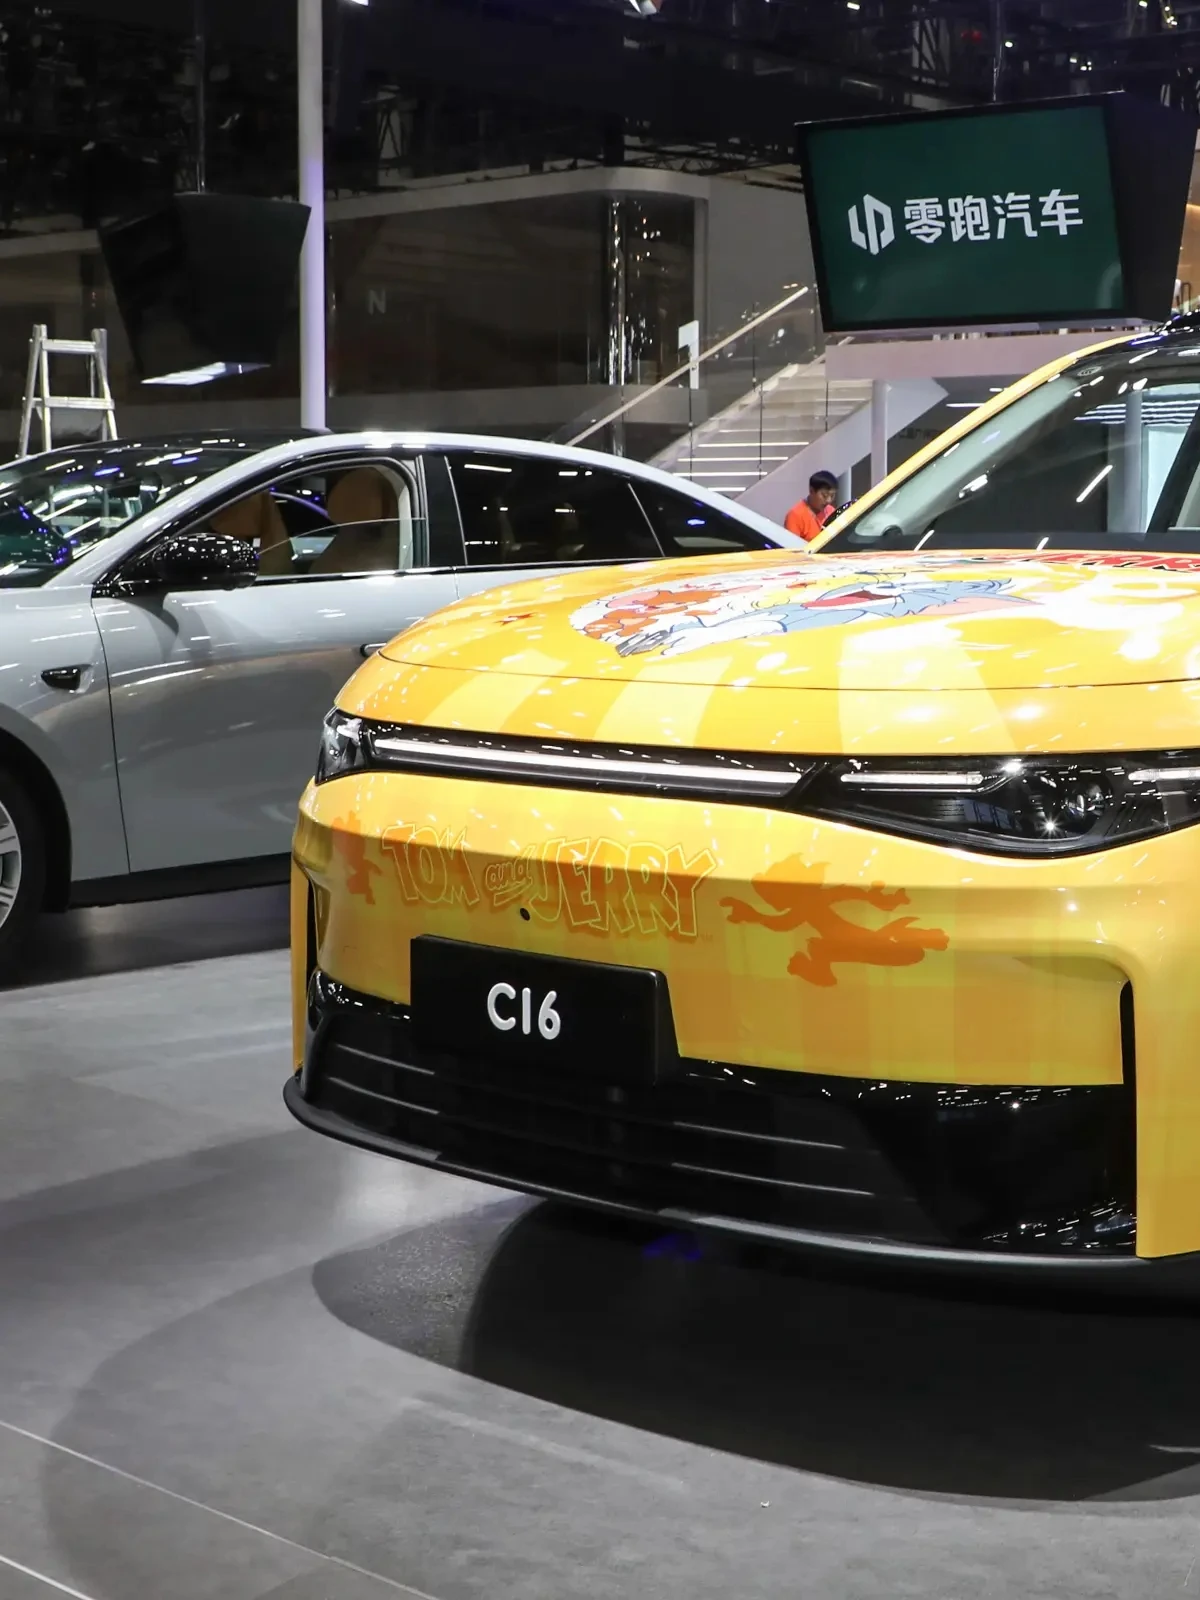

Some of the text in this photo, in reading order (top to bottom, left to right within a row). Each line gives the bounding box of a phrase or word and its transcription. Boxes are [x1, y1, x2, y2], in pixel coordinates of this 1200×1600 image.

[904, 188, 1083, 244] 零跑汽车
[381, 824, 716, 936] TOM and JERRY
[487, 982, 561, 1040] C16
